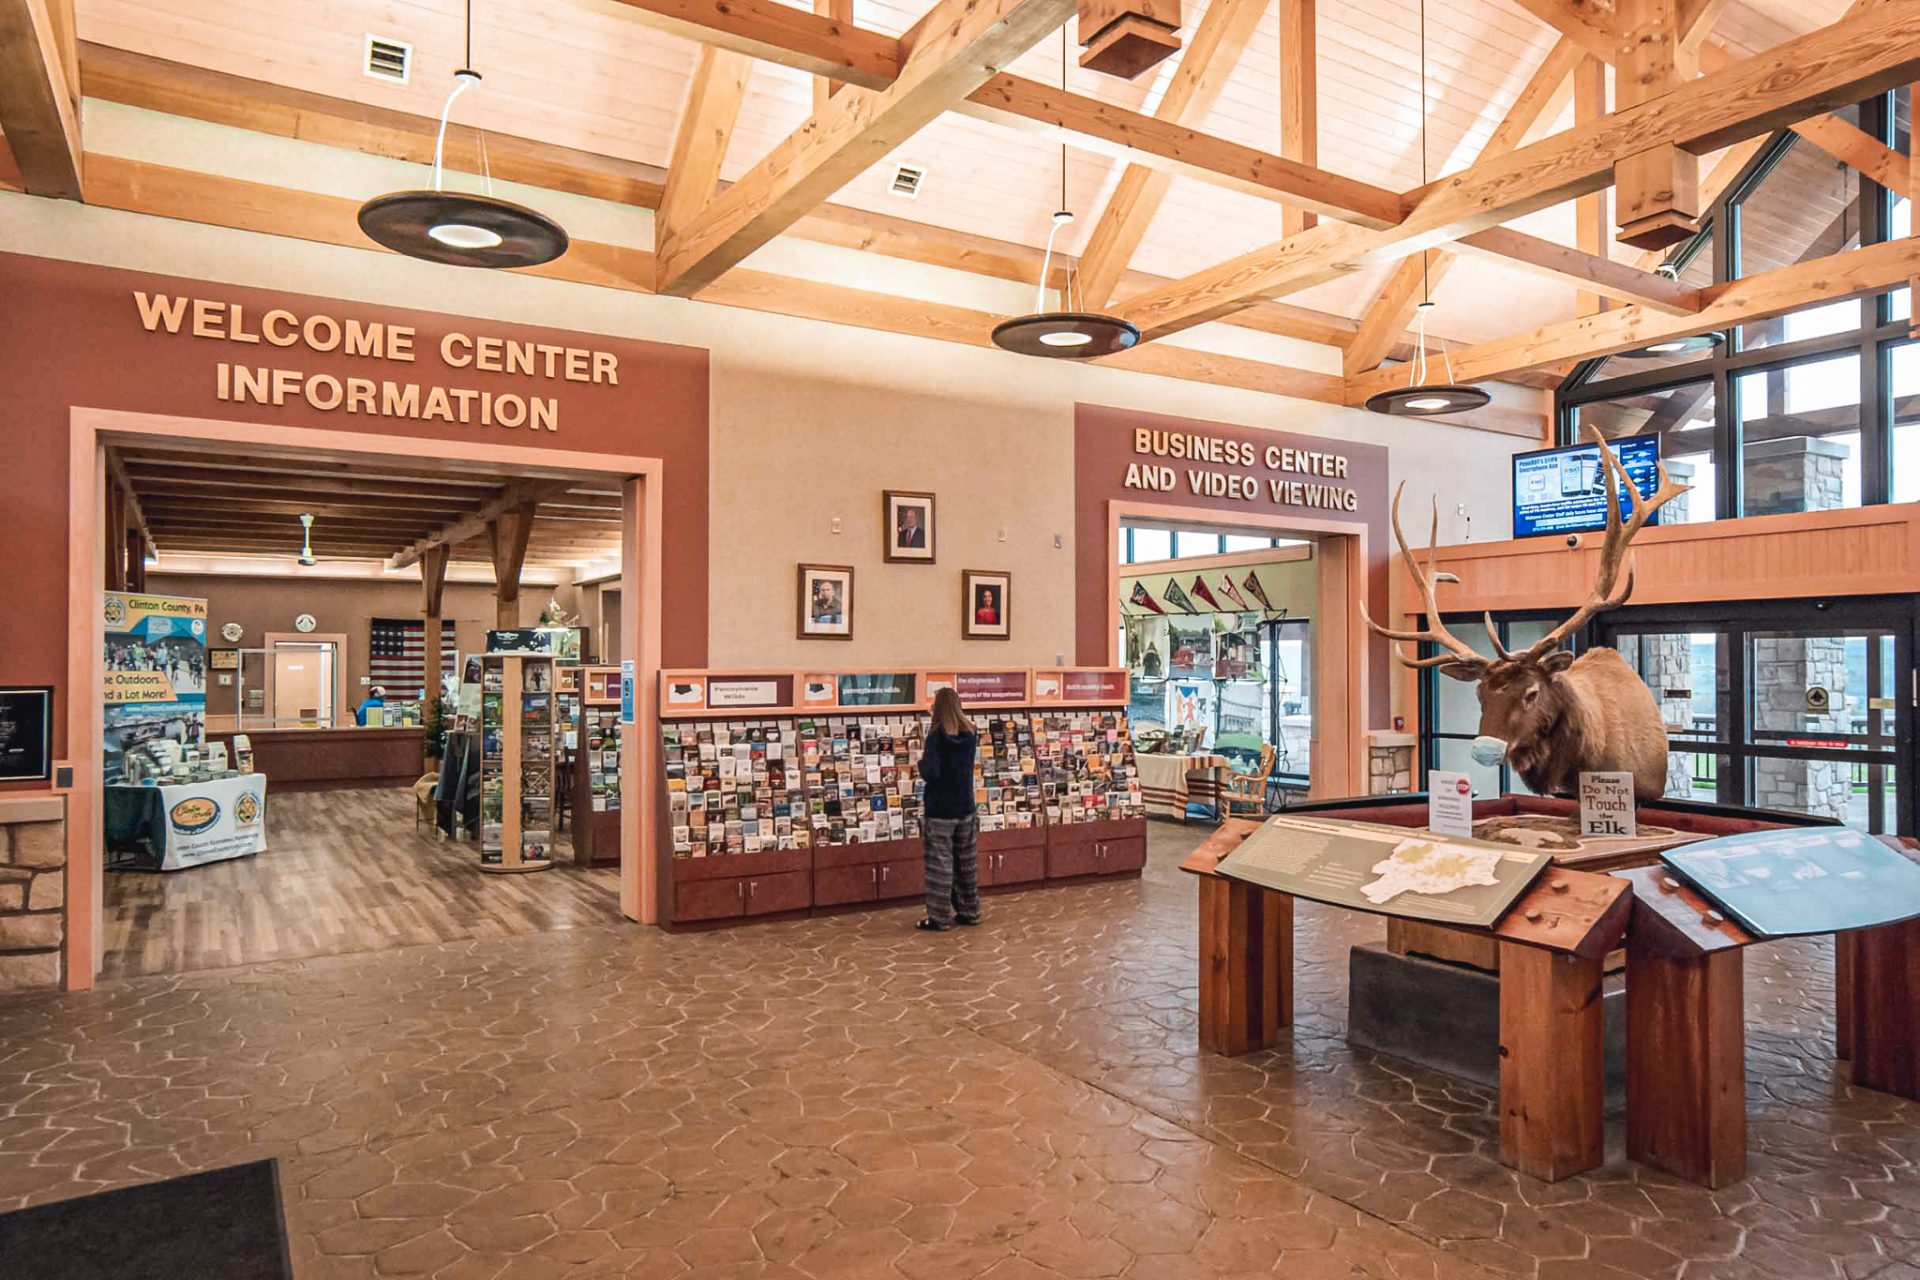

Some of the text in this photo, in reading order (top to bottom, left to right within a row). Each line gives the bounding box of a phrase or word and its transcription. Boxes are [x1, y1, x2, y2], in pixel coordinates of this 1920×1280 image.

[133, 290, 620, 386] WELCOME CENTER
[215, 362, 559, 432] INFORMATION
[1135, 427, 1348, 478] BUSINESS CENTER
[1124, 463, 1358, 512] AND VIDEO VIEWING
[128, 599, 160, 611] Clinton
[195, 604, 205, 613] PA
[125, 689, 140, 699] Lot
[142, 689, 167, 699] More!
[1591, 775, 1620, 784] Please
[1583, 785, 1630, 795] Do Not
[1585, 795, 1627, 811] Touch
[1588, 820, 1628, 835] Elk
